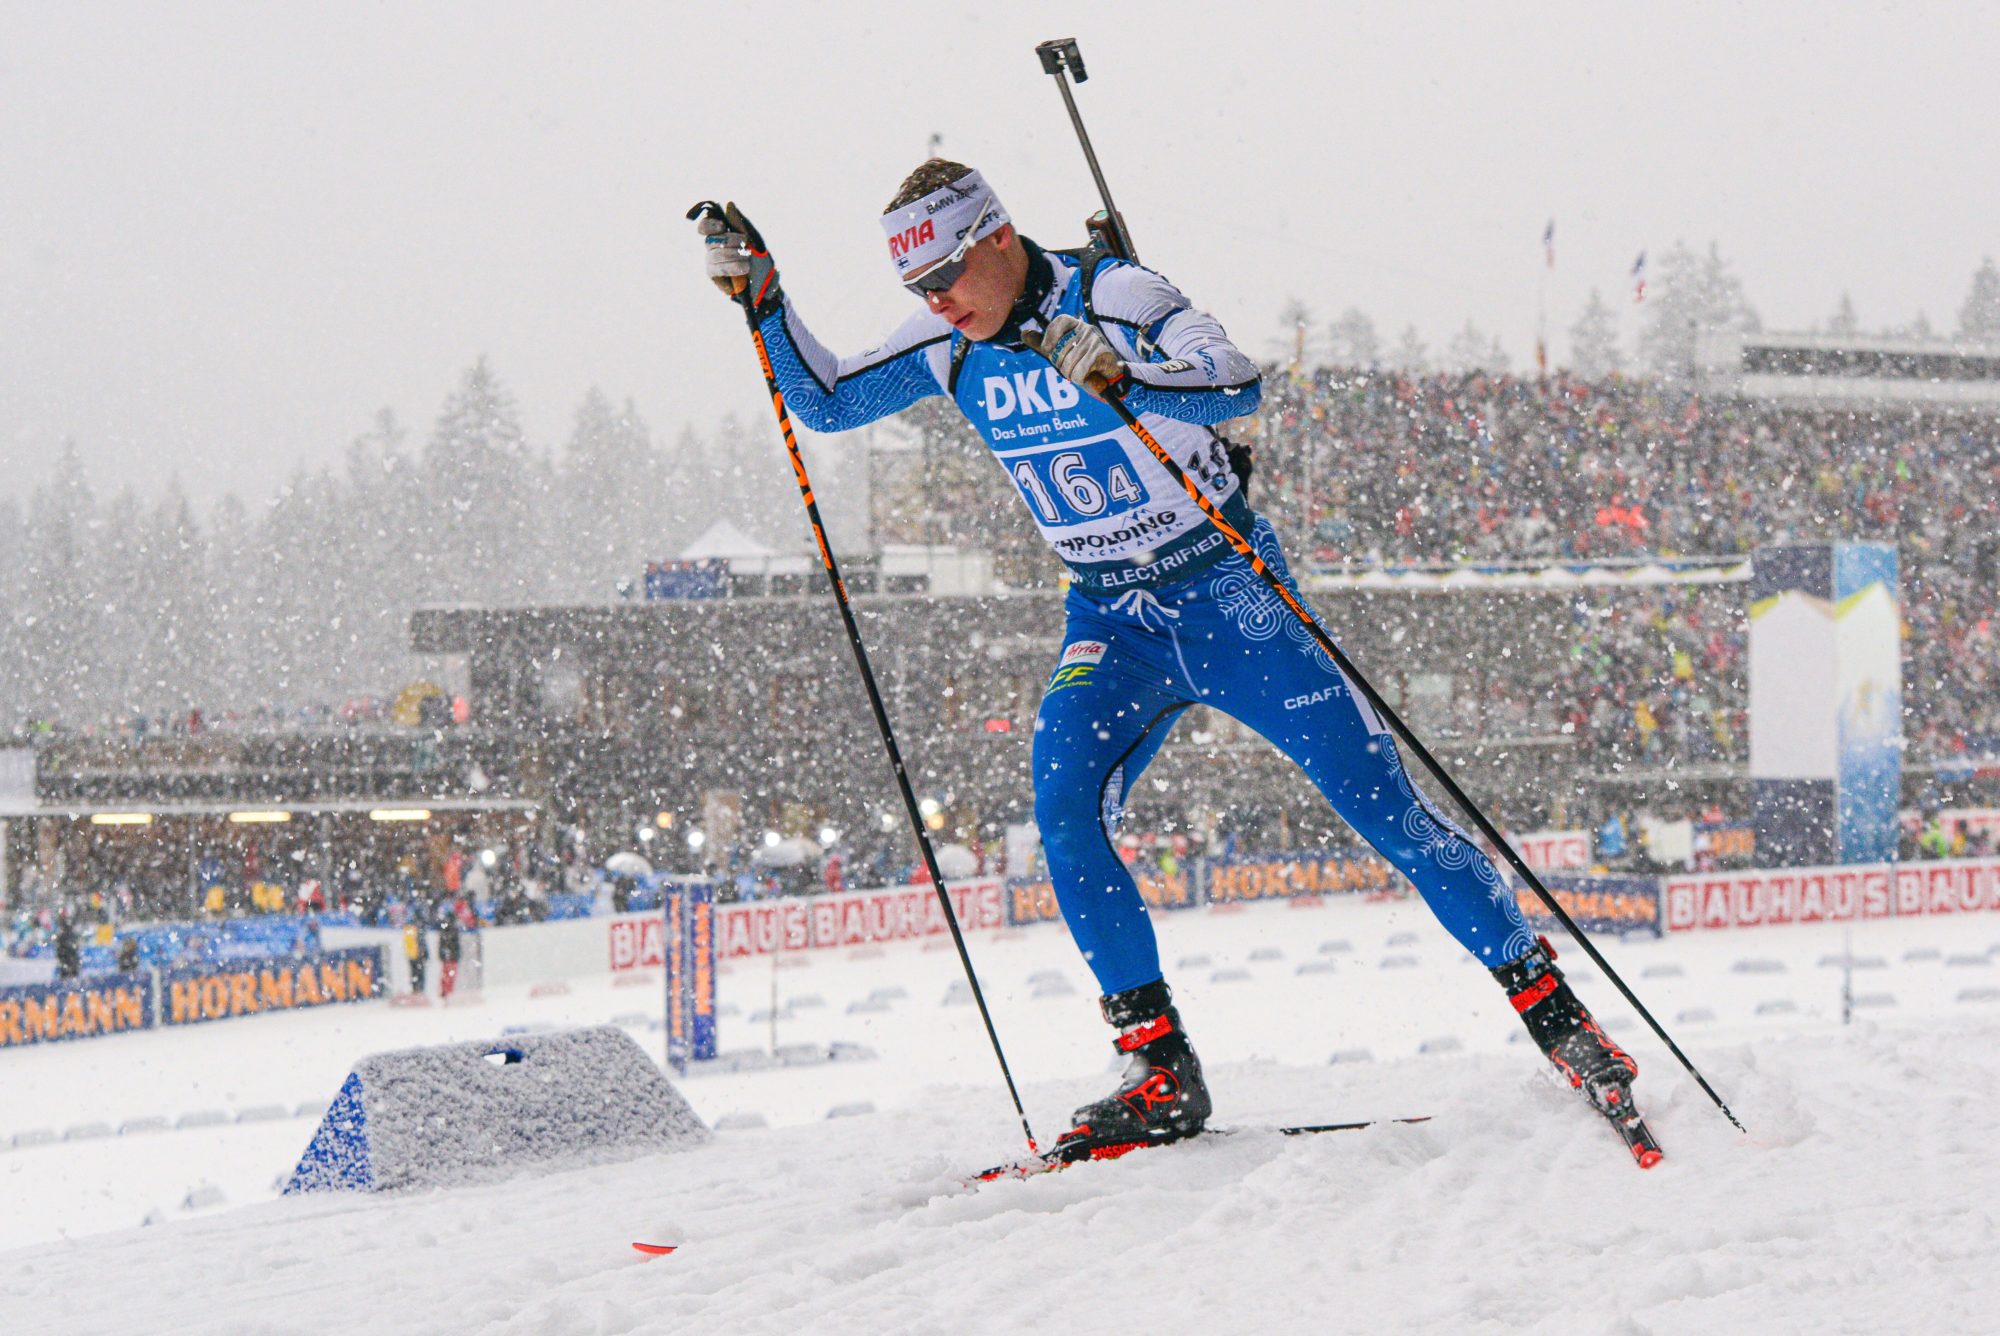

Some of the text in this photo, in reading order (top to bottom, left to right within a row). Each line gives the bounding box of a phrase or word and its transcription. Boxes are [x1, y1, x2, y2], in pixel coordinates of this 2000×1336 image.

[926, 194, 955, 216] BMW
[956, 212, 993, 241] CFT
[983, 365, 1080, 421] DKB
[992, 414, 1088, 441] Das kann Bank
[1055, 510, 1177, 552] HPOLDING
[1101, 531, 1224, 588] ELECTRIFIED
[1284, 685, 1342, 710] CRAFT
[610, 904, 809, 970] BAAUS
[815, 883, 1002, 948] BAUHAUS
[1667, 872, 1890, 932] BAUHAUS
[0, 986, 143, 1044] RMANN
